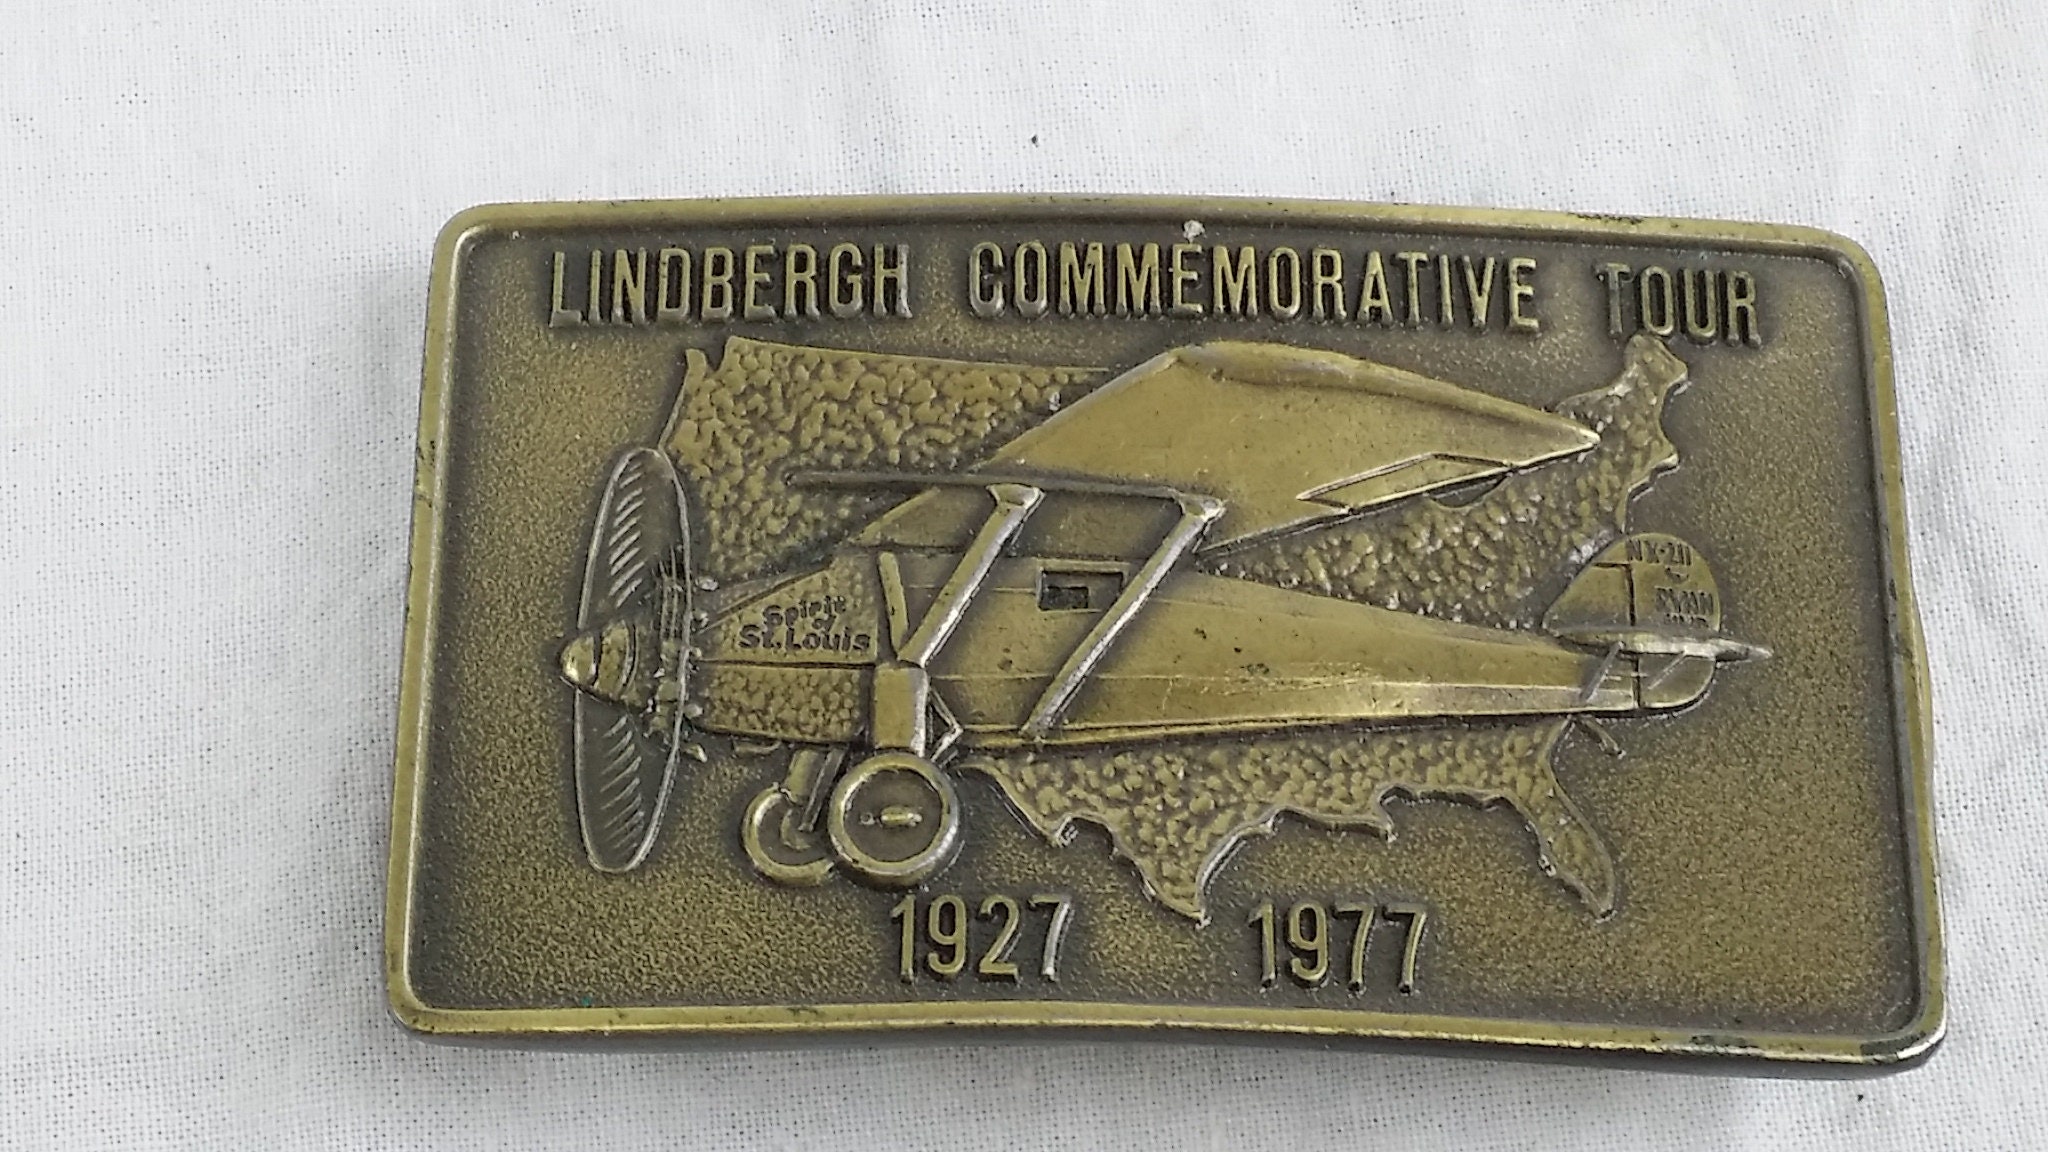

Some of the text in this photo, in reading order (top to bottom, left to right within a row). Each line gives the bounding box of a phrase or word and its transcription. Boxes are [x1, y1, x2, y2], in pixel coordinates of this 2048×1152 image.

[549, 240, 1764, 348] LINDBERGH COMMEMORATIVE TOUR
[762, 595, 847, 628] Spirit
[785, 625, 871, 651] Louis
[889, 894, 1430, 996] 1927 1977
